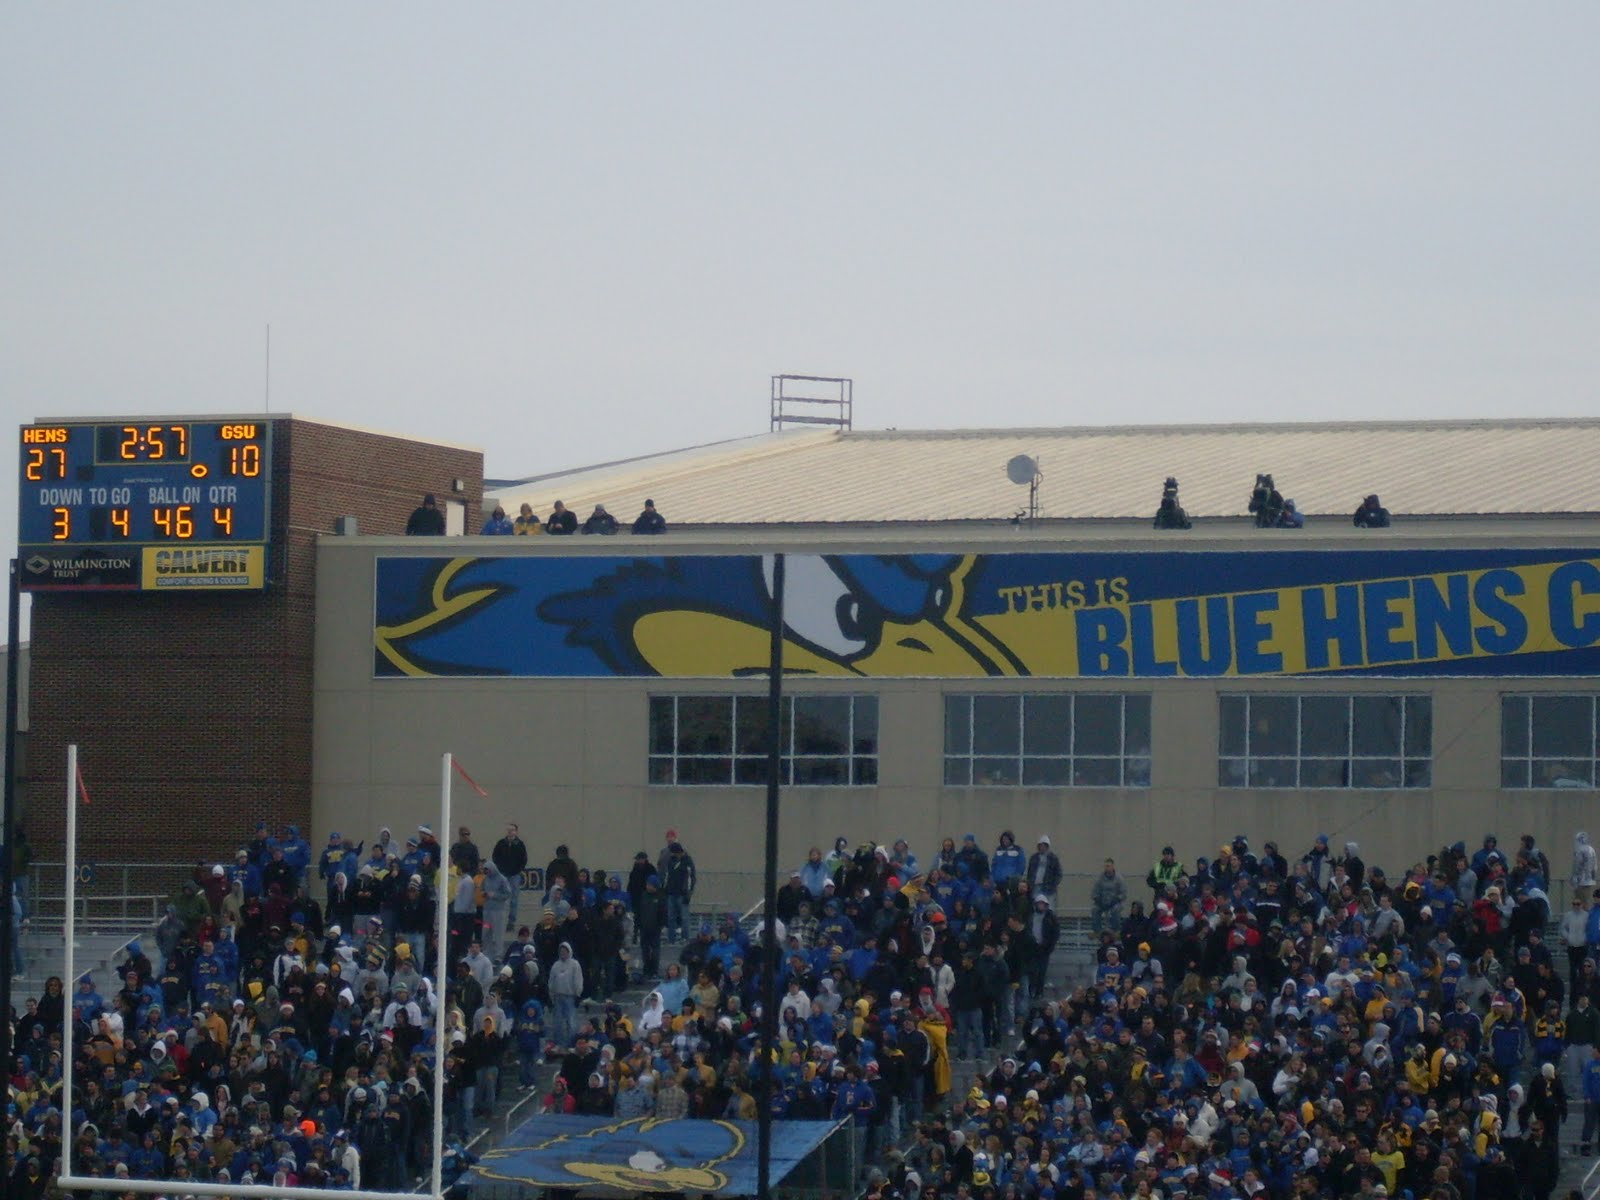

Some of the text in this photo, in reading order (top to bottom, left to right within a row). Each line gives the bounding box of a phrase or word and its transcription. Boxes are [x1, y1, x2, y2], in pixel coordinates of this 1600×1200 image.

[23, 429, 67, 443] HENS
[121, 426, 185, 459] 2:57
[221, 425, 255, 439] GSU
[27, 449, 65, 480] 27
[231, 445, 259, 476] 10
[40, 488, 82, 506] DOWN
[89, 487, 131, 505] TO GO
[148, 486, 200, 504] BALL ON
[208, 486, 237, 504] QTR
[54, 508, 69, 539] 3
[111, 509, 128, 536] 4
[154, 506, 192, 538] 46
[214, 507, 231, 535] 4
[52, 559, 131, 569] WILMINGTON
[53, 570, 80, 578] TRUST
[156, 549, 250, 574] CALVERT
[998, 577, 1130, 614] THIS IS
[1074, 591, 1284, 677] BLUE
[1301, 568, 1529, 670] HENS
